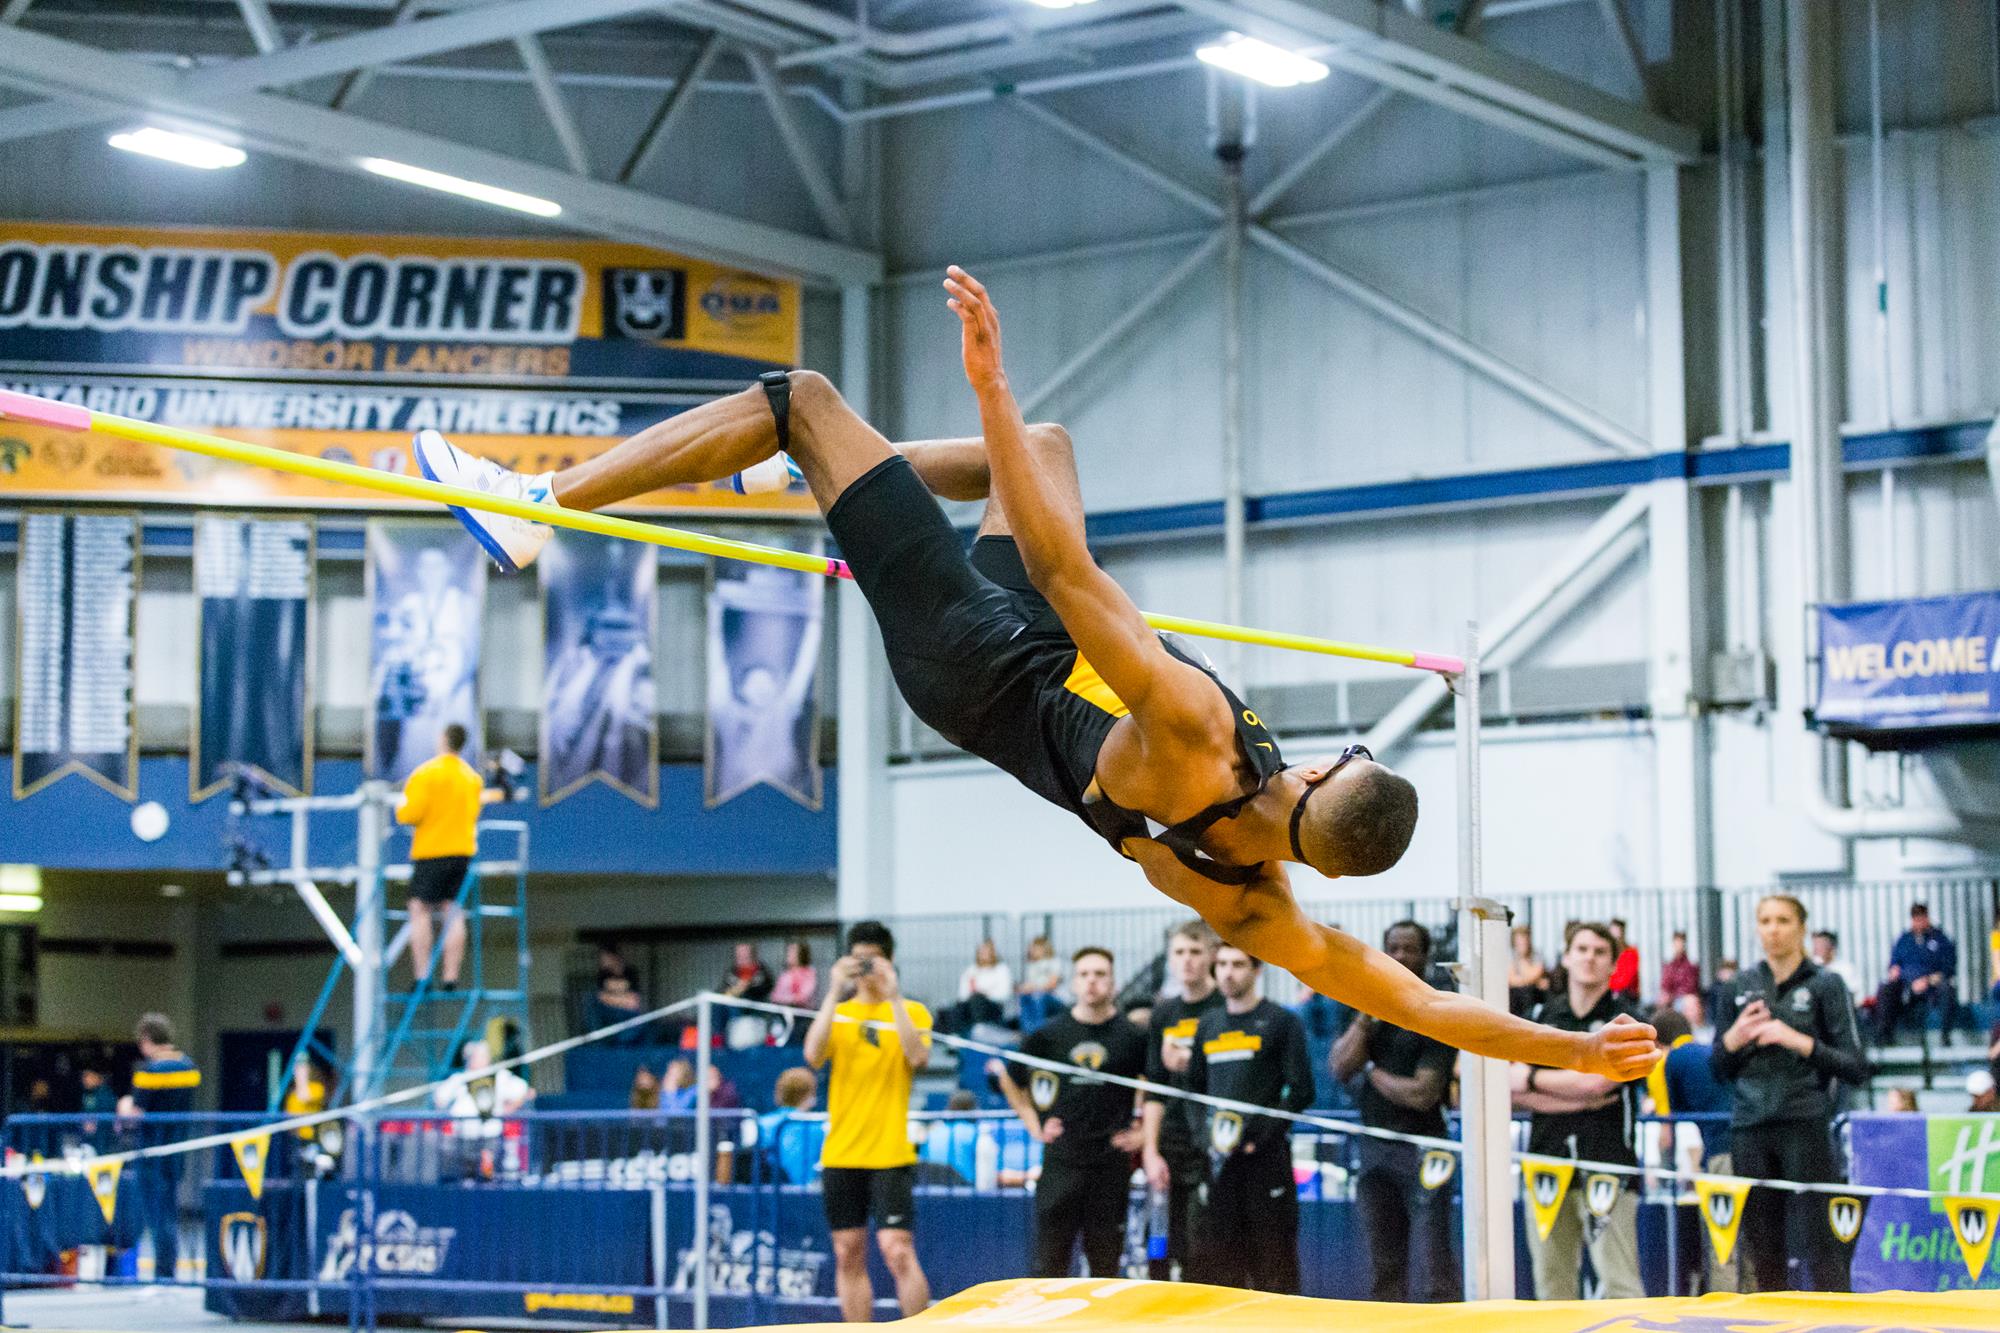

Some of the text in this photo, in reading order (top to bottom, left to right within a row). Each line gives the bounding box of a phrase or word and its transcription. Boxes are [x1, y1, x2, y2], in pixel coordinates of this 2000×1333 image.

[0, 246, 581, 338] ONSHIP CORNER
[184, 340, 375, 371] WINDSOR
[163, 390, 401, 430] UNIVERSITY
[404, 399, 621, 436] ATHLETICS
[1826, 637, 1987, 680] WELCOME
